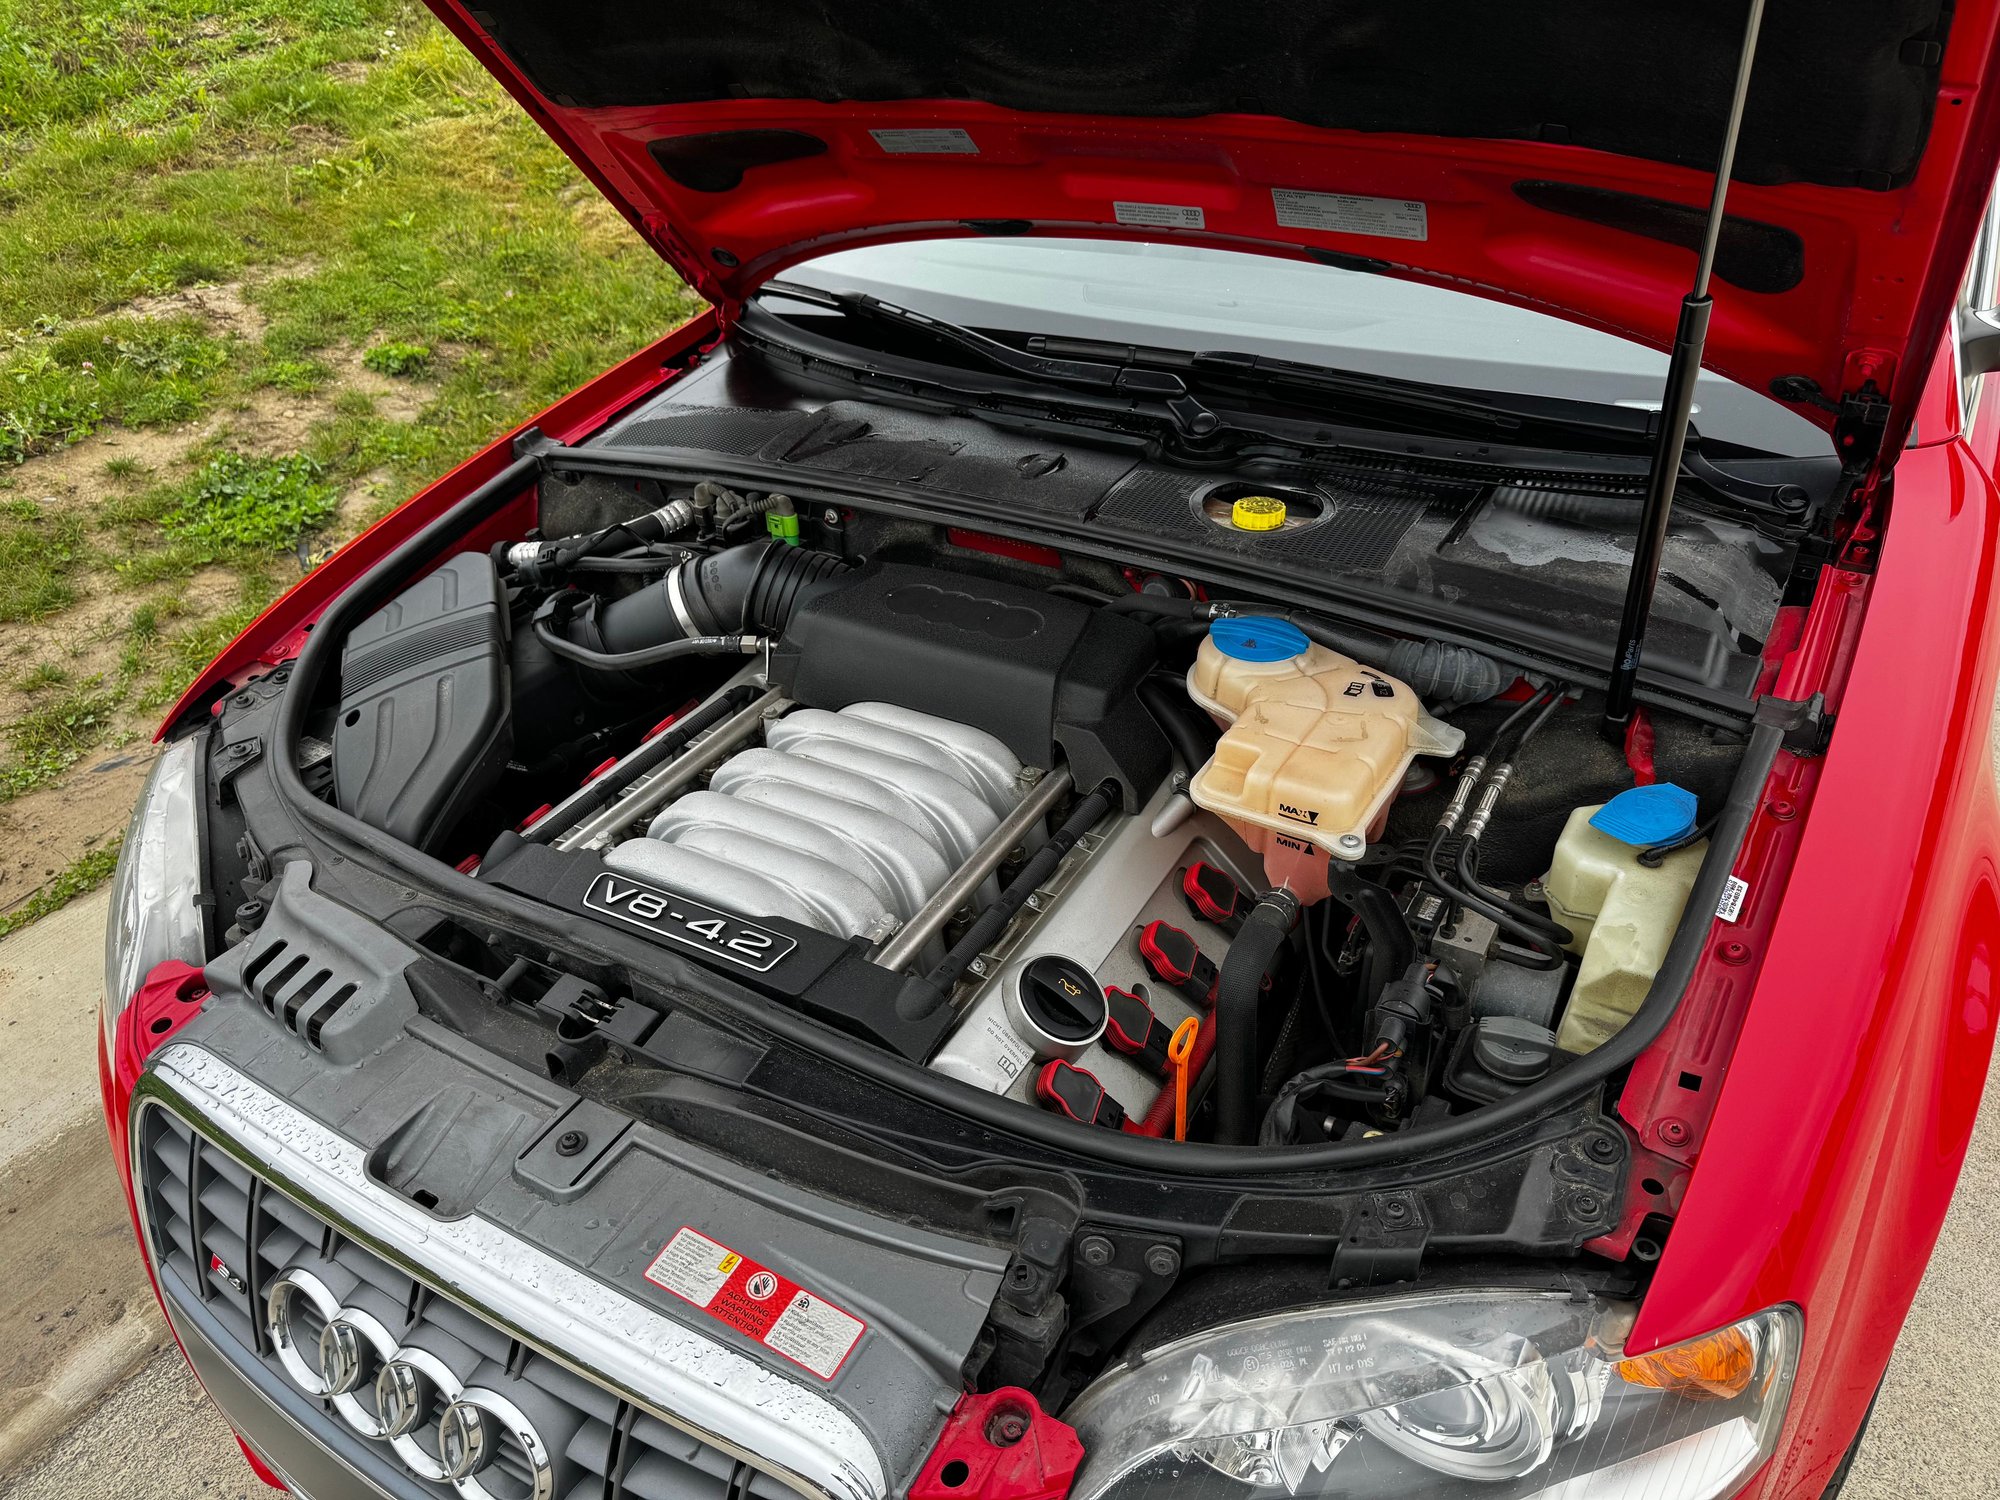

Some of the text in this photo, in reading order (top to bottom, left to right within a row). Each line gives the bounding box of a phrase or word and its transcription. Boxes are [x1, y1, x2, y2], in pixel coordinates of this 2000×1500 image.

[1276, 837, 1300, 851] MIN
[987, 1016, 1002, 1030] NICHT
[994, 1034, 1004, 1044] NOT
[721, 1297, 765, 1326] WARNING
[727, 1290, 770, 1318] ACHTUNG
[711, 1305, 761, 1335] ATTENTION
[1328, 1358, 1375, 1374] H7 or D1S
[1148, 1393, 1160, 1406] H7
